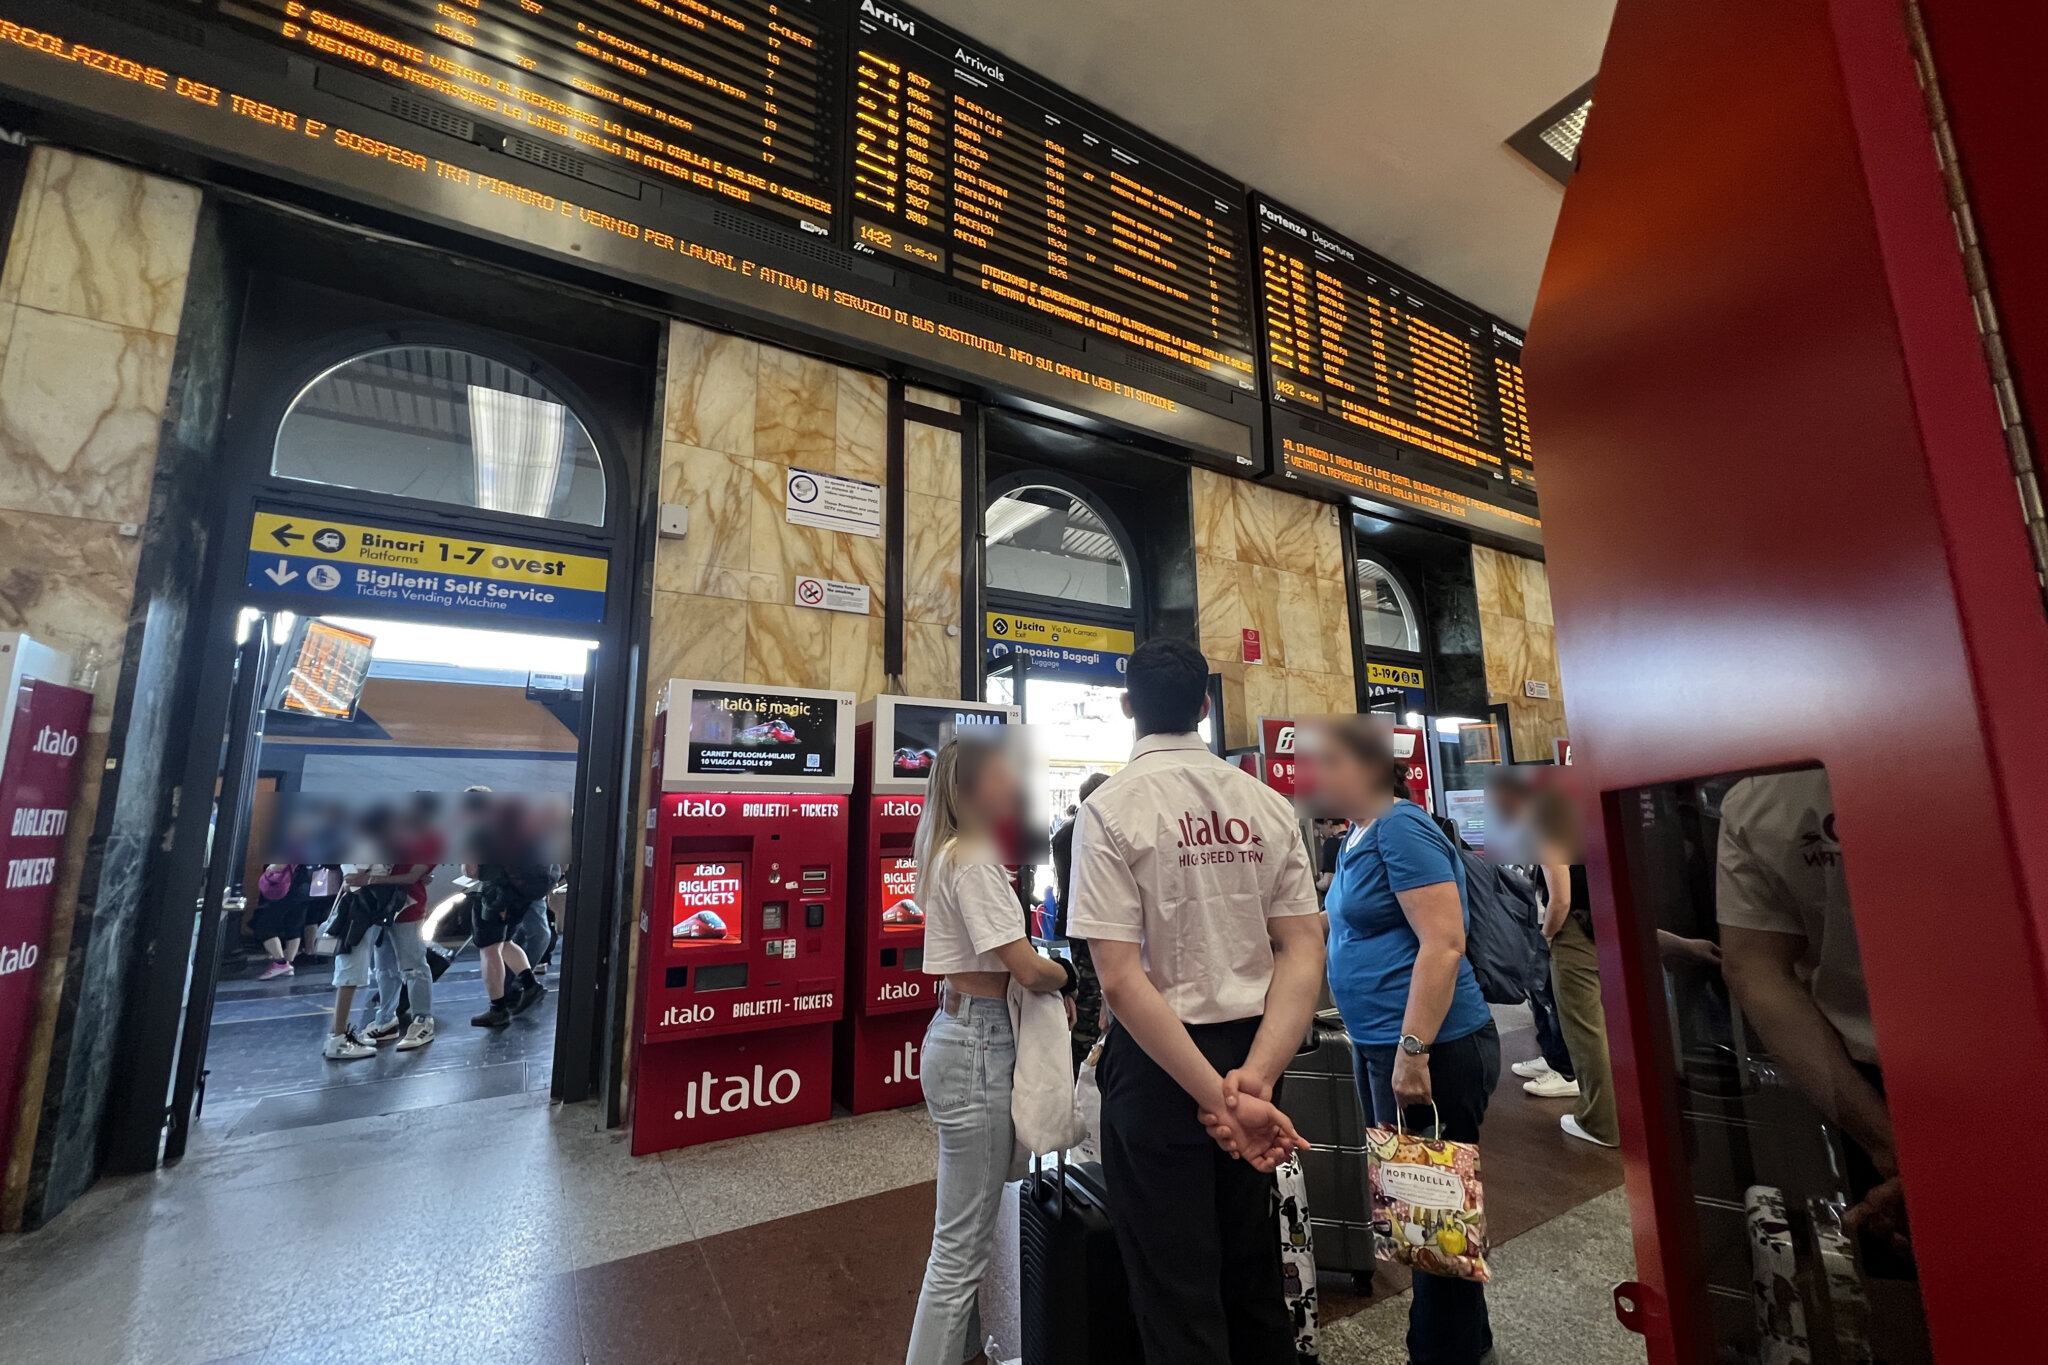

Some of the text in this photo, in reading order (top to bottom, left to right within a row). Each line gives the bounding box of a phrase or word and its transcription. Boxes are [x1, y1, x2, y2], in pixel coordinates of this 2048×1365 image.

[860, 0, 914, 36] Arrivi
[768, 36, 781, 48] 17
[955, 48, 1004, 82] Arrivals
[766, 68, 775, 79] 7
[764, 84, 774, 96] 3
[310, 10, 424, 63] SEVERAMENTE
[430, 54, 492, 88] VIETATO
[496, 80, 600, 128] OLTREPASSARE
[604, 120, 622, 136] LA
[626, 128, 664, 152] LINEA
[667, 144, 710, 170] GIALLA
[714, 161, 722, 174] E
[726, 166, 766, 190] SALIRE
[306, 30, 377, 66] VIETATO
[382, 58, 497, 110] OLTREPASSARE
[502, 102, 522, 120] LA
[526, 111, 569, 136] LINEA
[574, 129, 622, 156] GIALLA
[626, 147, 640, 162] IN
[644, 154, 689, 180] ATTESA
[692, 172, 714, 190] DEI
[718, 180, 750, 202] TRENI
[764, 101, 778, 116] 16
[762, 136, 772, 146] 4
[762, 152, 776, 164] 17
[175, 78, 221, 107] DEI
[230, 94, 298, 131] TRENI
[334, 128, 428, 172] SOSPESA
[436, 160, 471, 186] TRA
[478, 175, 556, 212] PIANORO
[561, 201, 573, 218] E
[580, 207, 639, 239] VERNIO
[644, 228, 675, 251] PER
[760, 266, 807, 294] ATTIVO
[812, 283, 830, 301] UN
[834, 290, 891, 320] SERVIZIO
[895, 309, 908, 326] DI
[912, 315, 935, 334] BUS
[1009, 347, 1033, 366] INFO
[1036, 356, 1054, 372] SUI
[1056, 363, 1090, 385] CANALI
[1092, 374, 1112, 392] WEB
[1114, 382, 1121, 395] E
[1124, 385, 1134, 399] IN
[860, 226, 892, 248] 14:22
[1260, 204, 1354, 261] Partenze Departures
[359, 547, 419, 565] Platforms
[361, 532, 566, 576] Binari 1-7 ovest
[356, 568, 556, 604] Biglietti Self Service
[356, 584, 508, 610] Tickets Vending Machine
[1015, 620, 1046, 632] Uscita
[1052, 624, 1062, 632] Via
[1015, 630, 1026, 638] Exit
[1031, 658, 1060, 668] Luggage
[1062, 652, 1100, 664] Bagagli
[1372, 666, 1390, 678] 3-19
[755, 698, 768, 712] is
[770, 701, 811, 718] magic
[700, 758, 710, 766] 10
[710, 758, 735, 766] VIAGGI
[732, 750, 796, 760] BOLOGNA-MILANO
[742, 803, 790, 818] BIGLIETTI
[800, 803, 838, 818] TICKETS
[11, 807, 69, 837] BIGLIETTI
[6, 857, 56, 889] TICKETS
[678, 879, 739, 894] BIGLIETTI
[682, 892, 735, 906] TICKETS
[732, 998, 782, 1018] BIGLIETTI
[793, 993, 833, 1012] TICKETS
[1386, 1168, 1452, 1187] MORTADELLA
